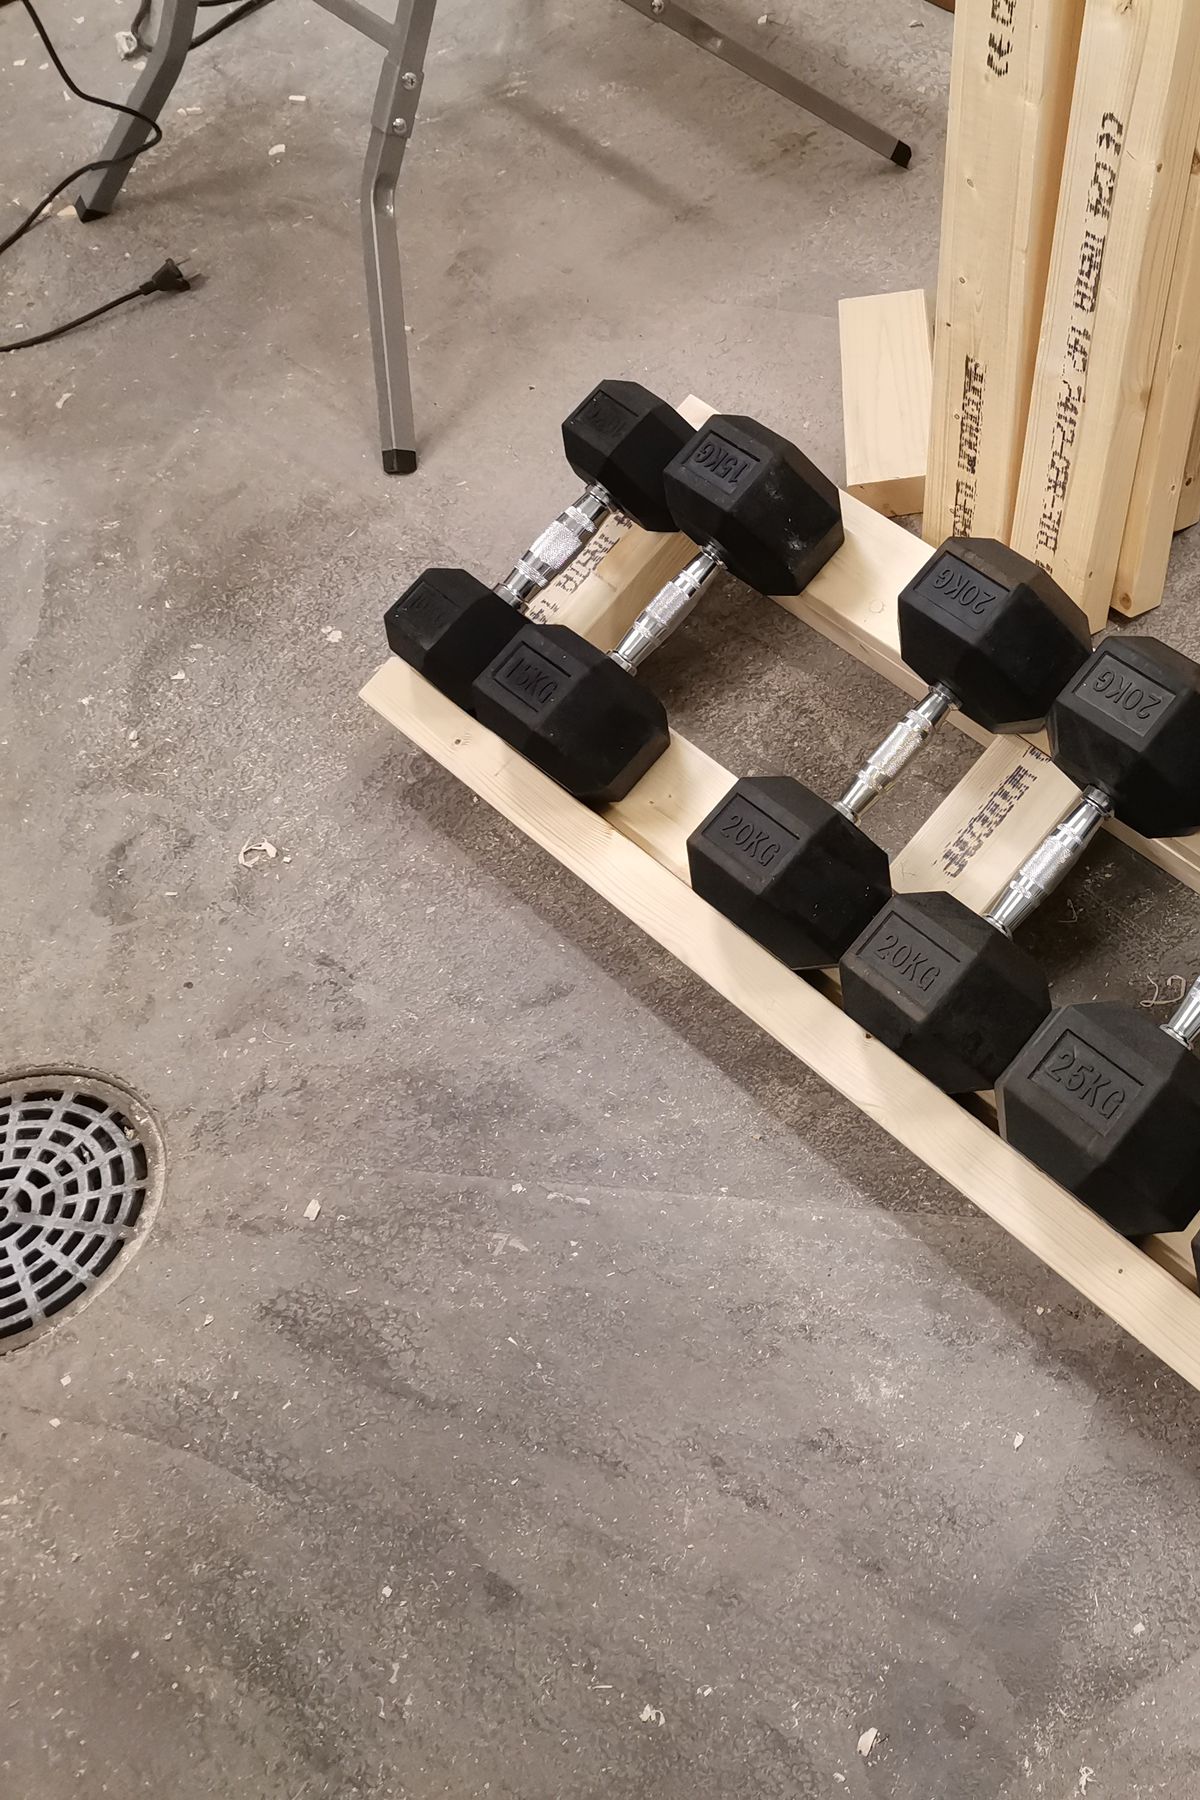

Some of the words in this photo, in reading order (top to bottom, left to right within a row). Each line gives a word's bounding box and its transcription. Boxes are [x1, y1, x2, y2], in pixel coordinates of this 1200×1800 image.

[1097, 111, 1124, 152] CE
[694, 441, 749, 484] 15KG
[930, 566, 999, 616] 20KG
[505, 657, 560, 704] 15KG
[1094, 669, 1164, 720] 20KG
[718, 811, 784, 868] 20KG
[875, 932, 942, 993] 20KG
[1045, 1051, 1128, 1121] 25KG
